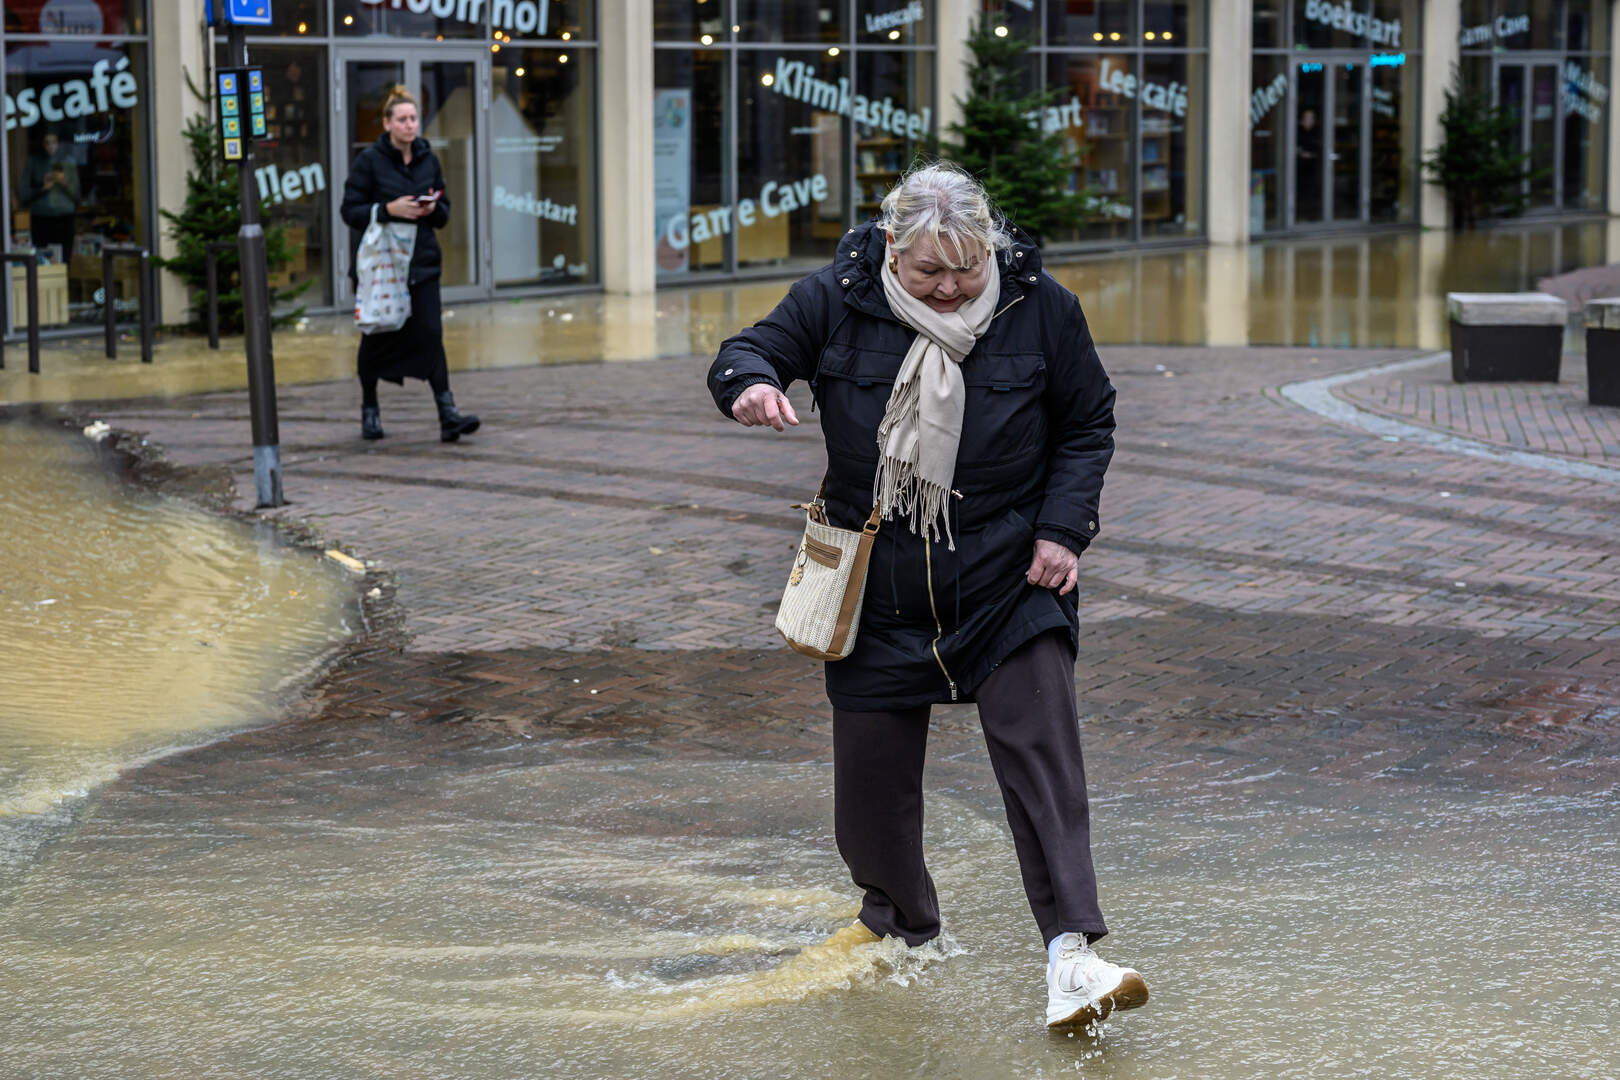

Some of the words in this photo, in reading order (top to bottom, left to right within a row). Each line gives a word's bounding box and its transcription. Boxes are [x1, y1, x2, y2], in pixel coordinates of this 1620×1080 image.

[773, 57, 931, 140] Klimkasteel
[1099, 59, 1188, 117] Leecafé
[494, 186, 577, 225] Boekstart
[667, 198, 755, 250] Game
[760, 174, 828, 217] Cave
